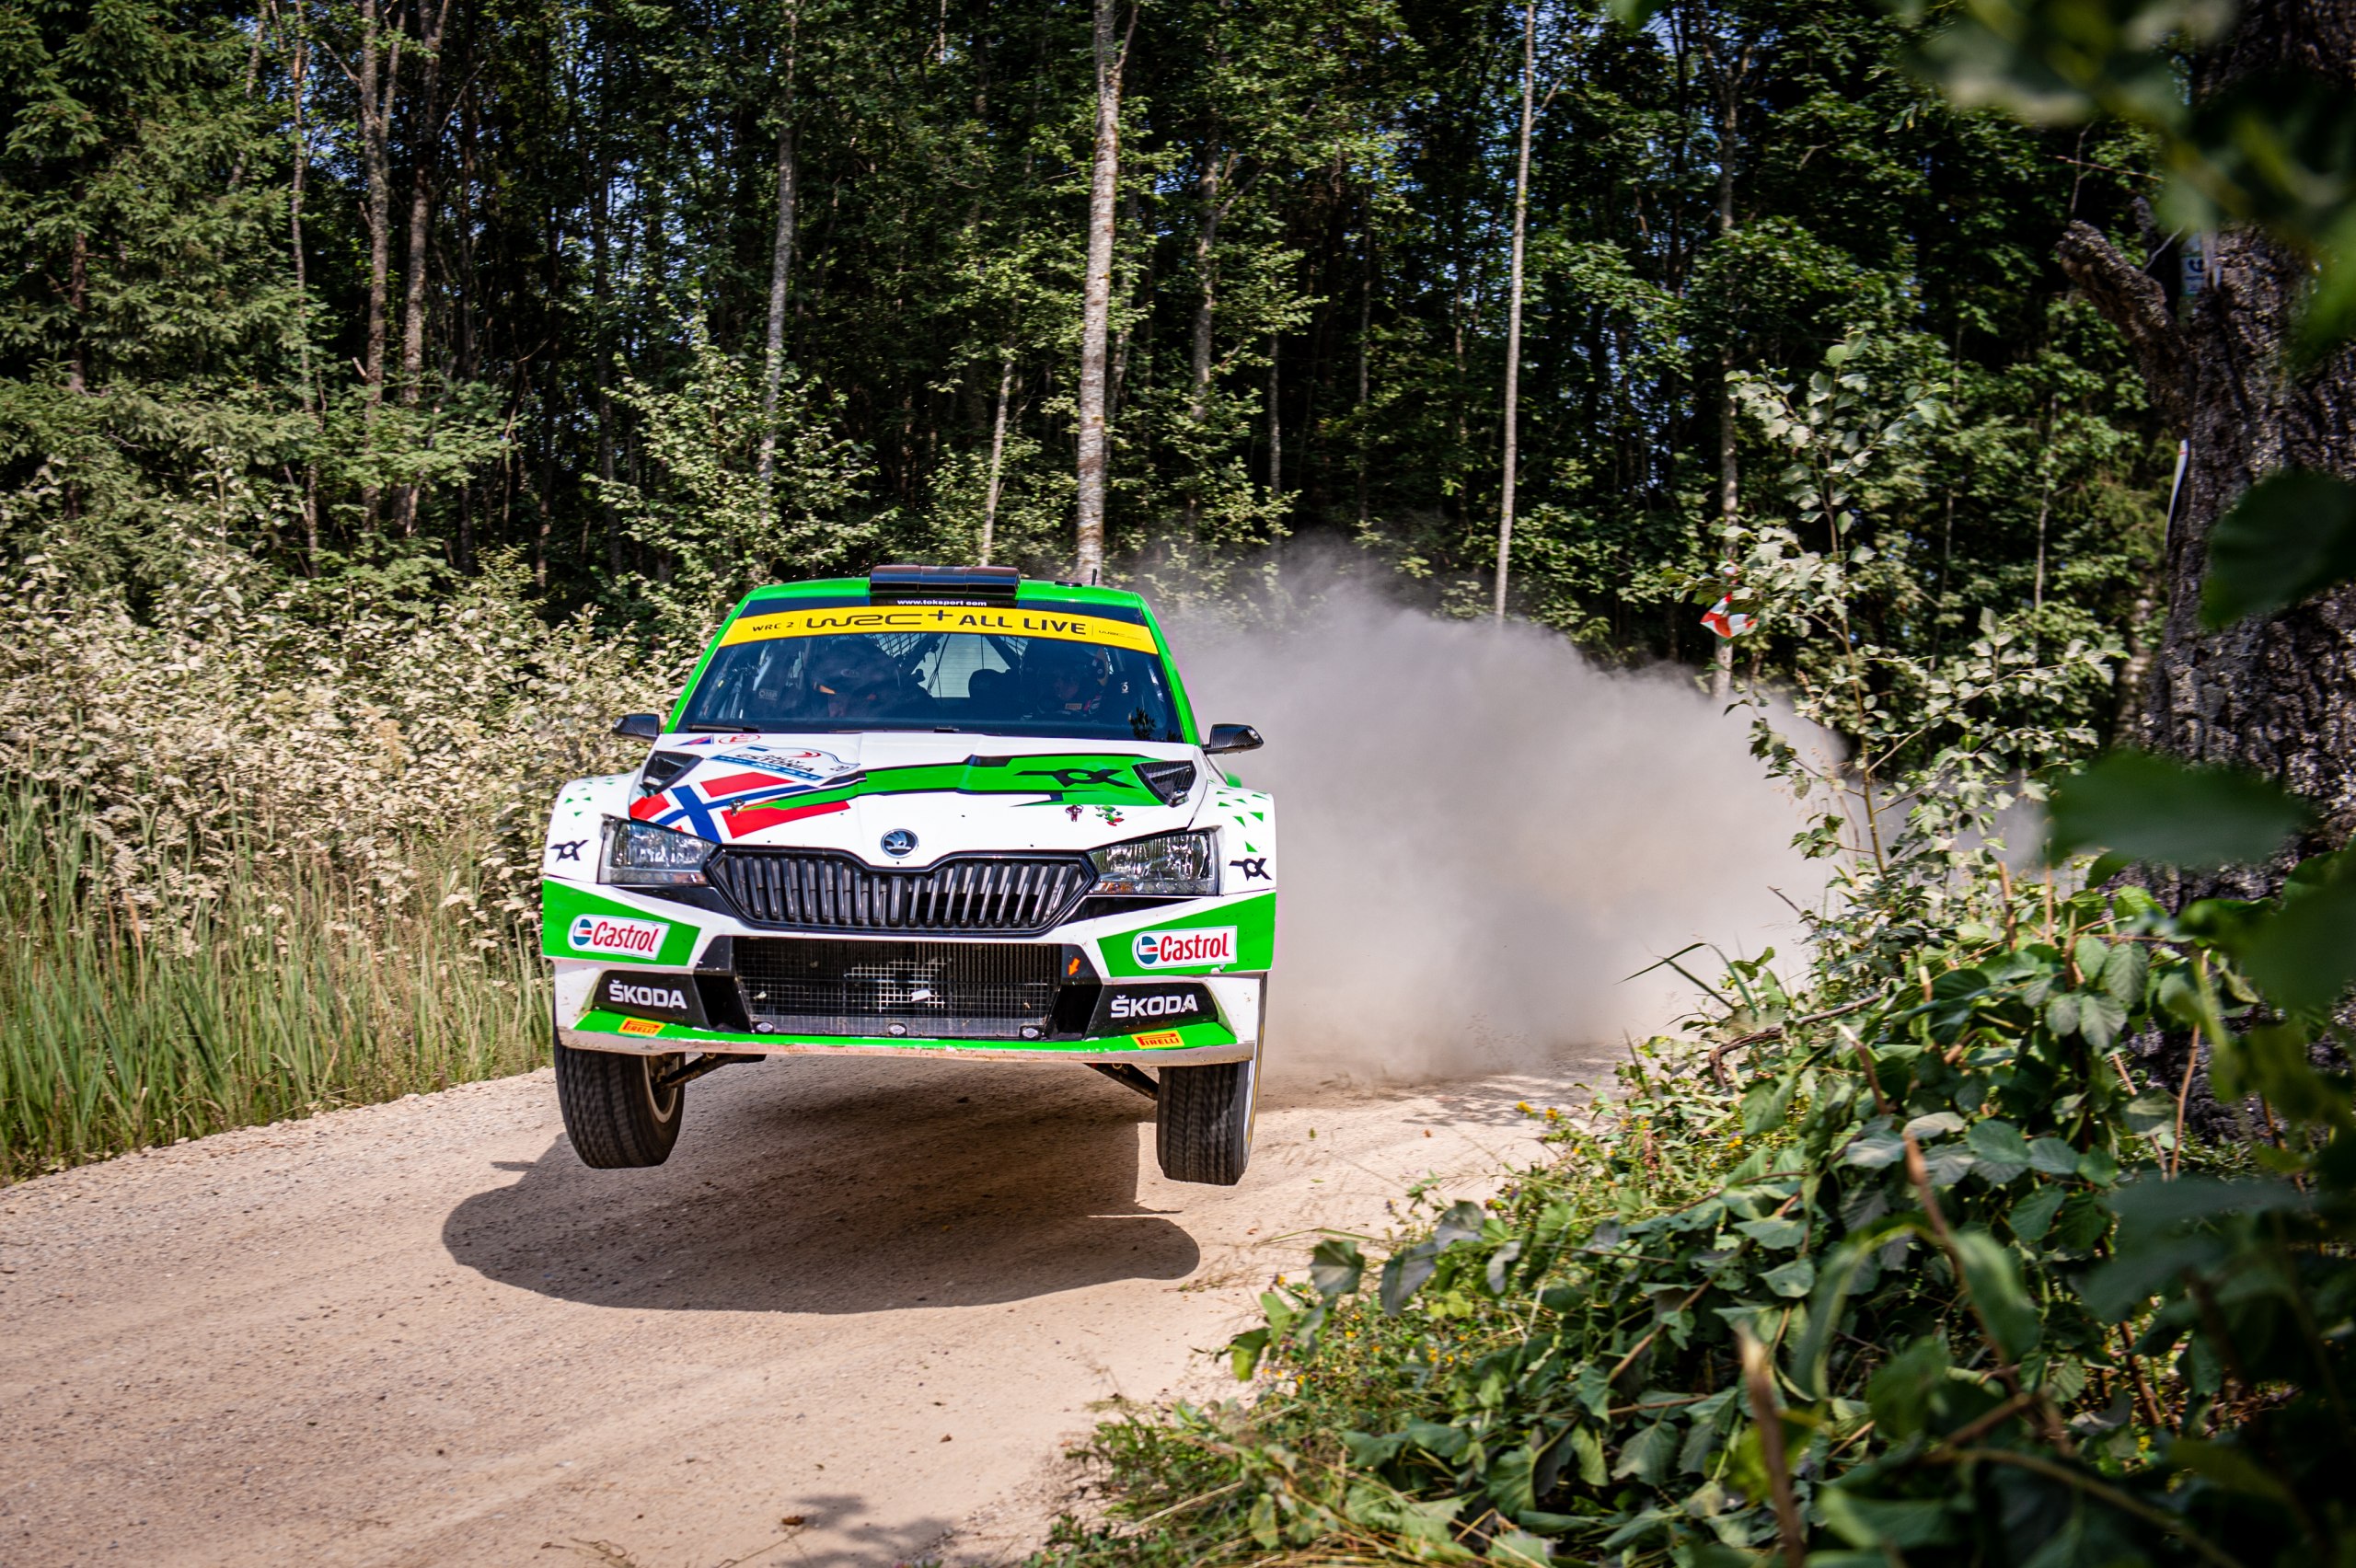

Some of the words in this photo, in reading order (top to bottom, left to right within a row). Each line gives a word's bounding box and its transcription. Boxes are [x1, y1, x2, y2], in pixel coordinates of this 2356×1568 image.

[752, 623, 781, 632] WRC
[958, 615, 1012, 628] ALL
[1023, 617, 1086, 635] LIVE
[593, 921, 660, 952] Castrol
[1160, 932, 1230, 963] Castrol
[609, 979, 687, 1009] ŠKODA
[1111, 994, 1198, 1019] ŠKODA
[622, 1020, 661, 1034] PIRELLI
[1137, 1032, 1180, 1046] PIRELLI
